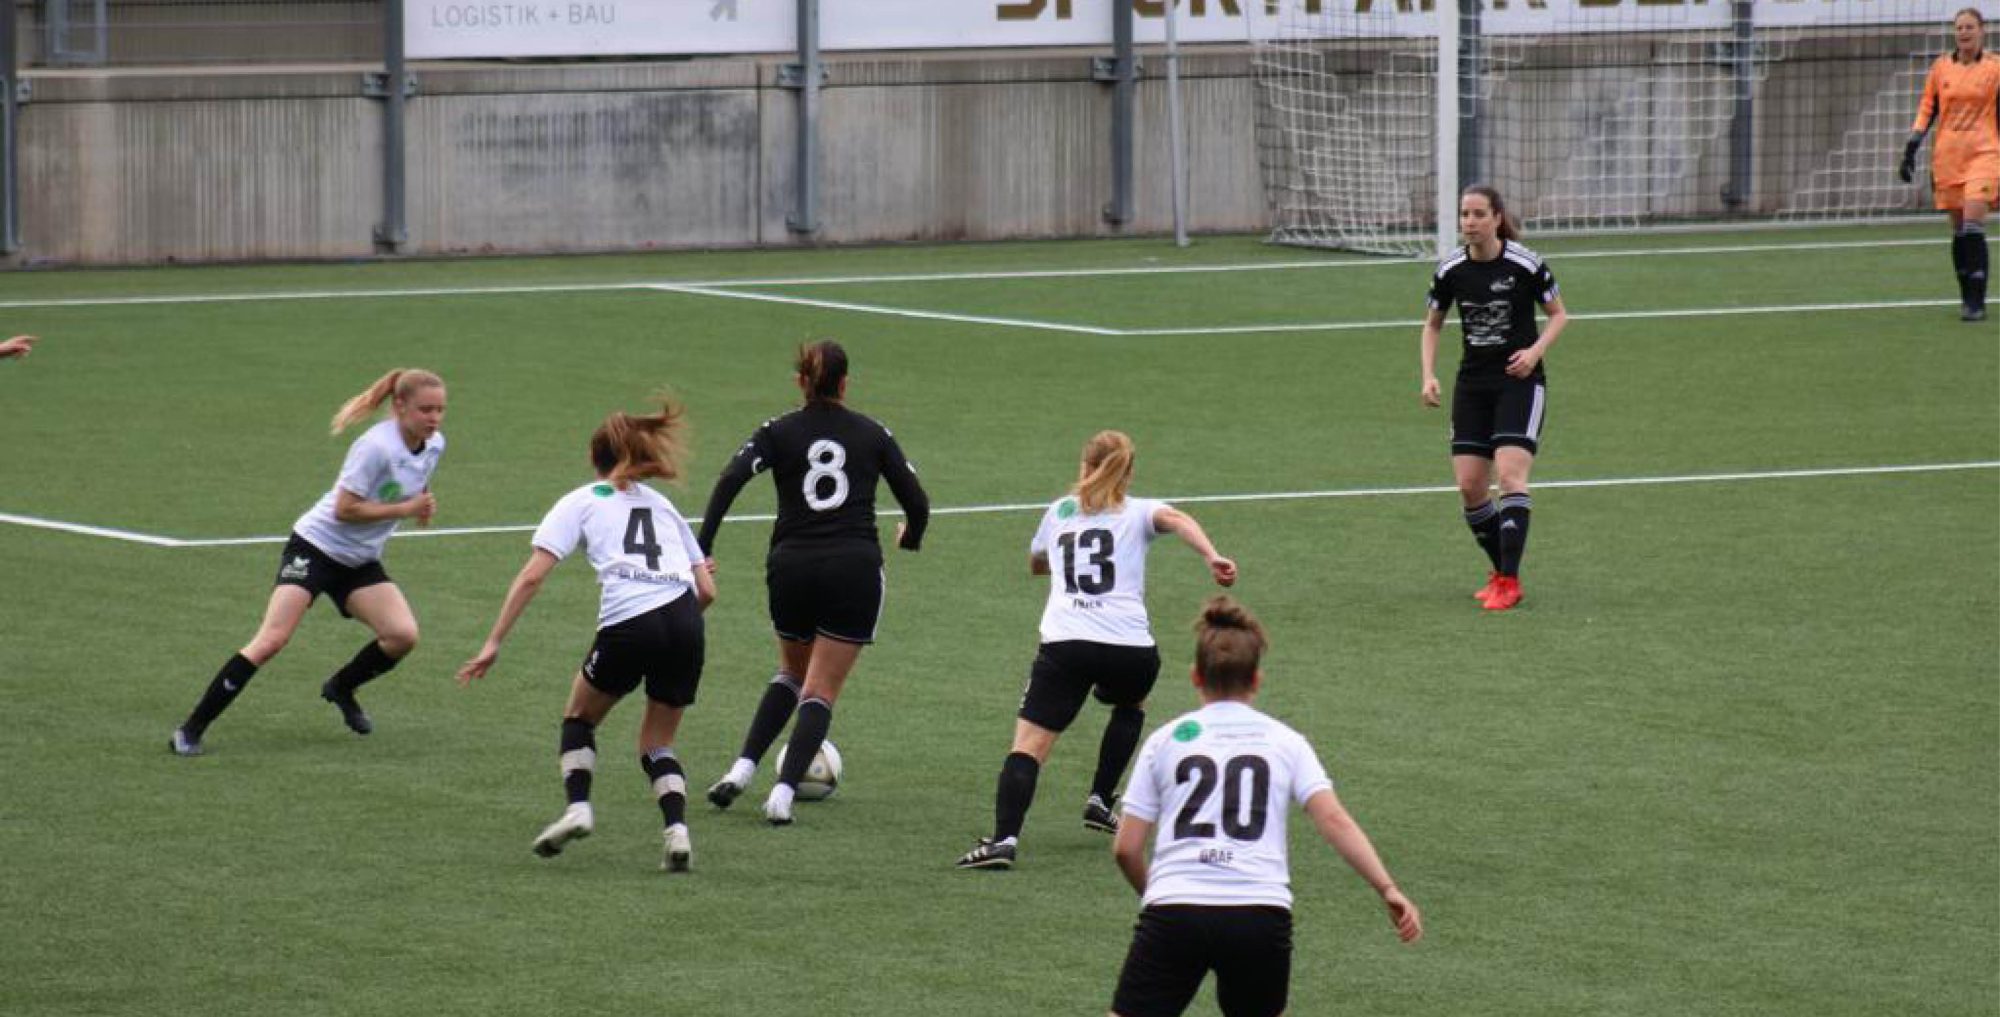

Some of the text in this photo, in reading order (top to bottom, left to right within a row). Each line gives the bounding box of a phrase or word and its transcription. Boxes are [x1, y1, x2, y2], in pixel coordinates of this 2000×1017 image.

[431, 4, 539, 28] LOGISTIK
[568, 5, 616, 25] BAU
[803, 439, 849, 511] 8
[623, 507, 663, 571] 4
[1057, 528, 1115, 595] 13
[1174, 754, 1270, 841] 20
